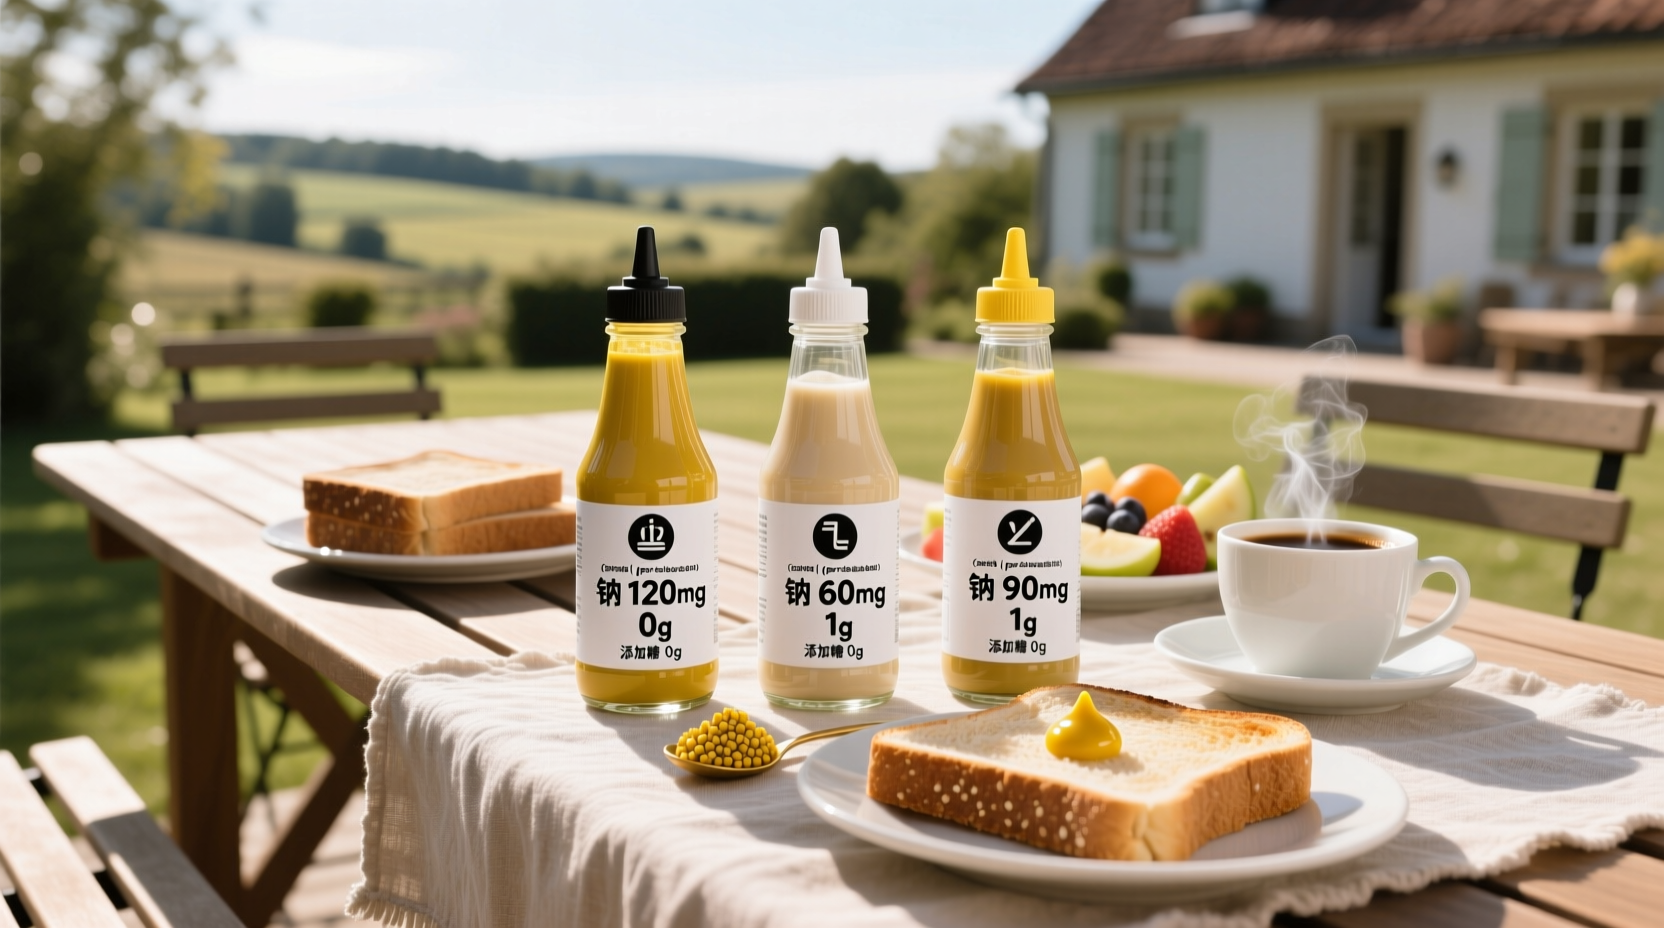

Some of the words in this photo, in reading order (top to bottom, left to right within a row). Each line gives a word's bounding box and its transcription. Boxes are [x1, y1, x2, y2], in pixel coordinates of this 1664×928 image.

[596, 577, 622, 607] 钠
[628, 579, 706, 608] 120mg
[785, 577, 811, 607] 钠
[818, 579, 886, 608] 60mg
[969, 572, 995, 602] 钠
[1002, 575, 1069, 604] 90mg
[638, 611, 672, 642] 0g
[825, 611, 853, 642] 1g
[1009, 606, 1037, 637] 1g
[665, 645, 682, 661] 0g
[847, 644, 864, 660] 0g
[1031, 640, 1047, 655] 0g
